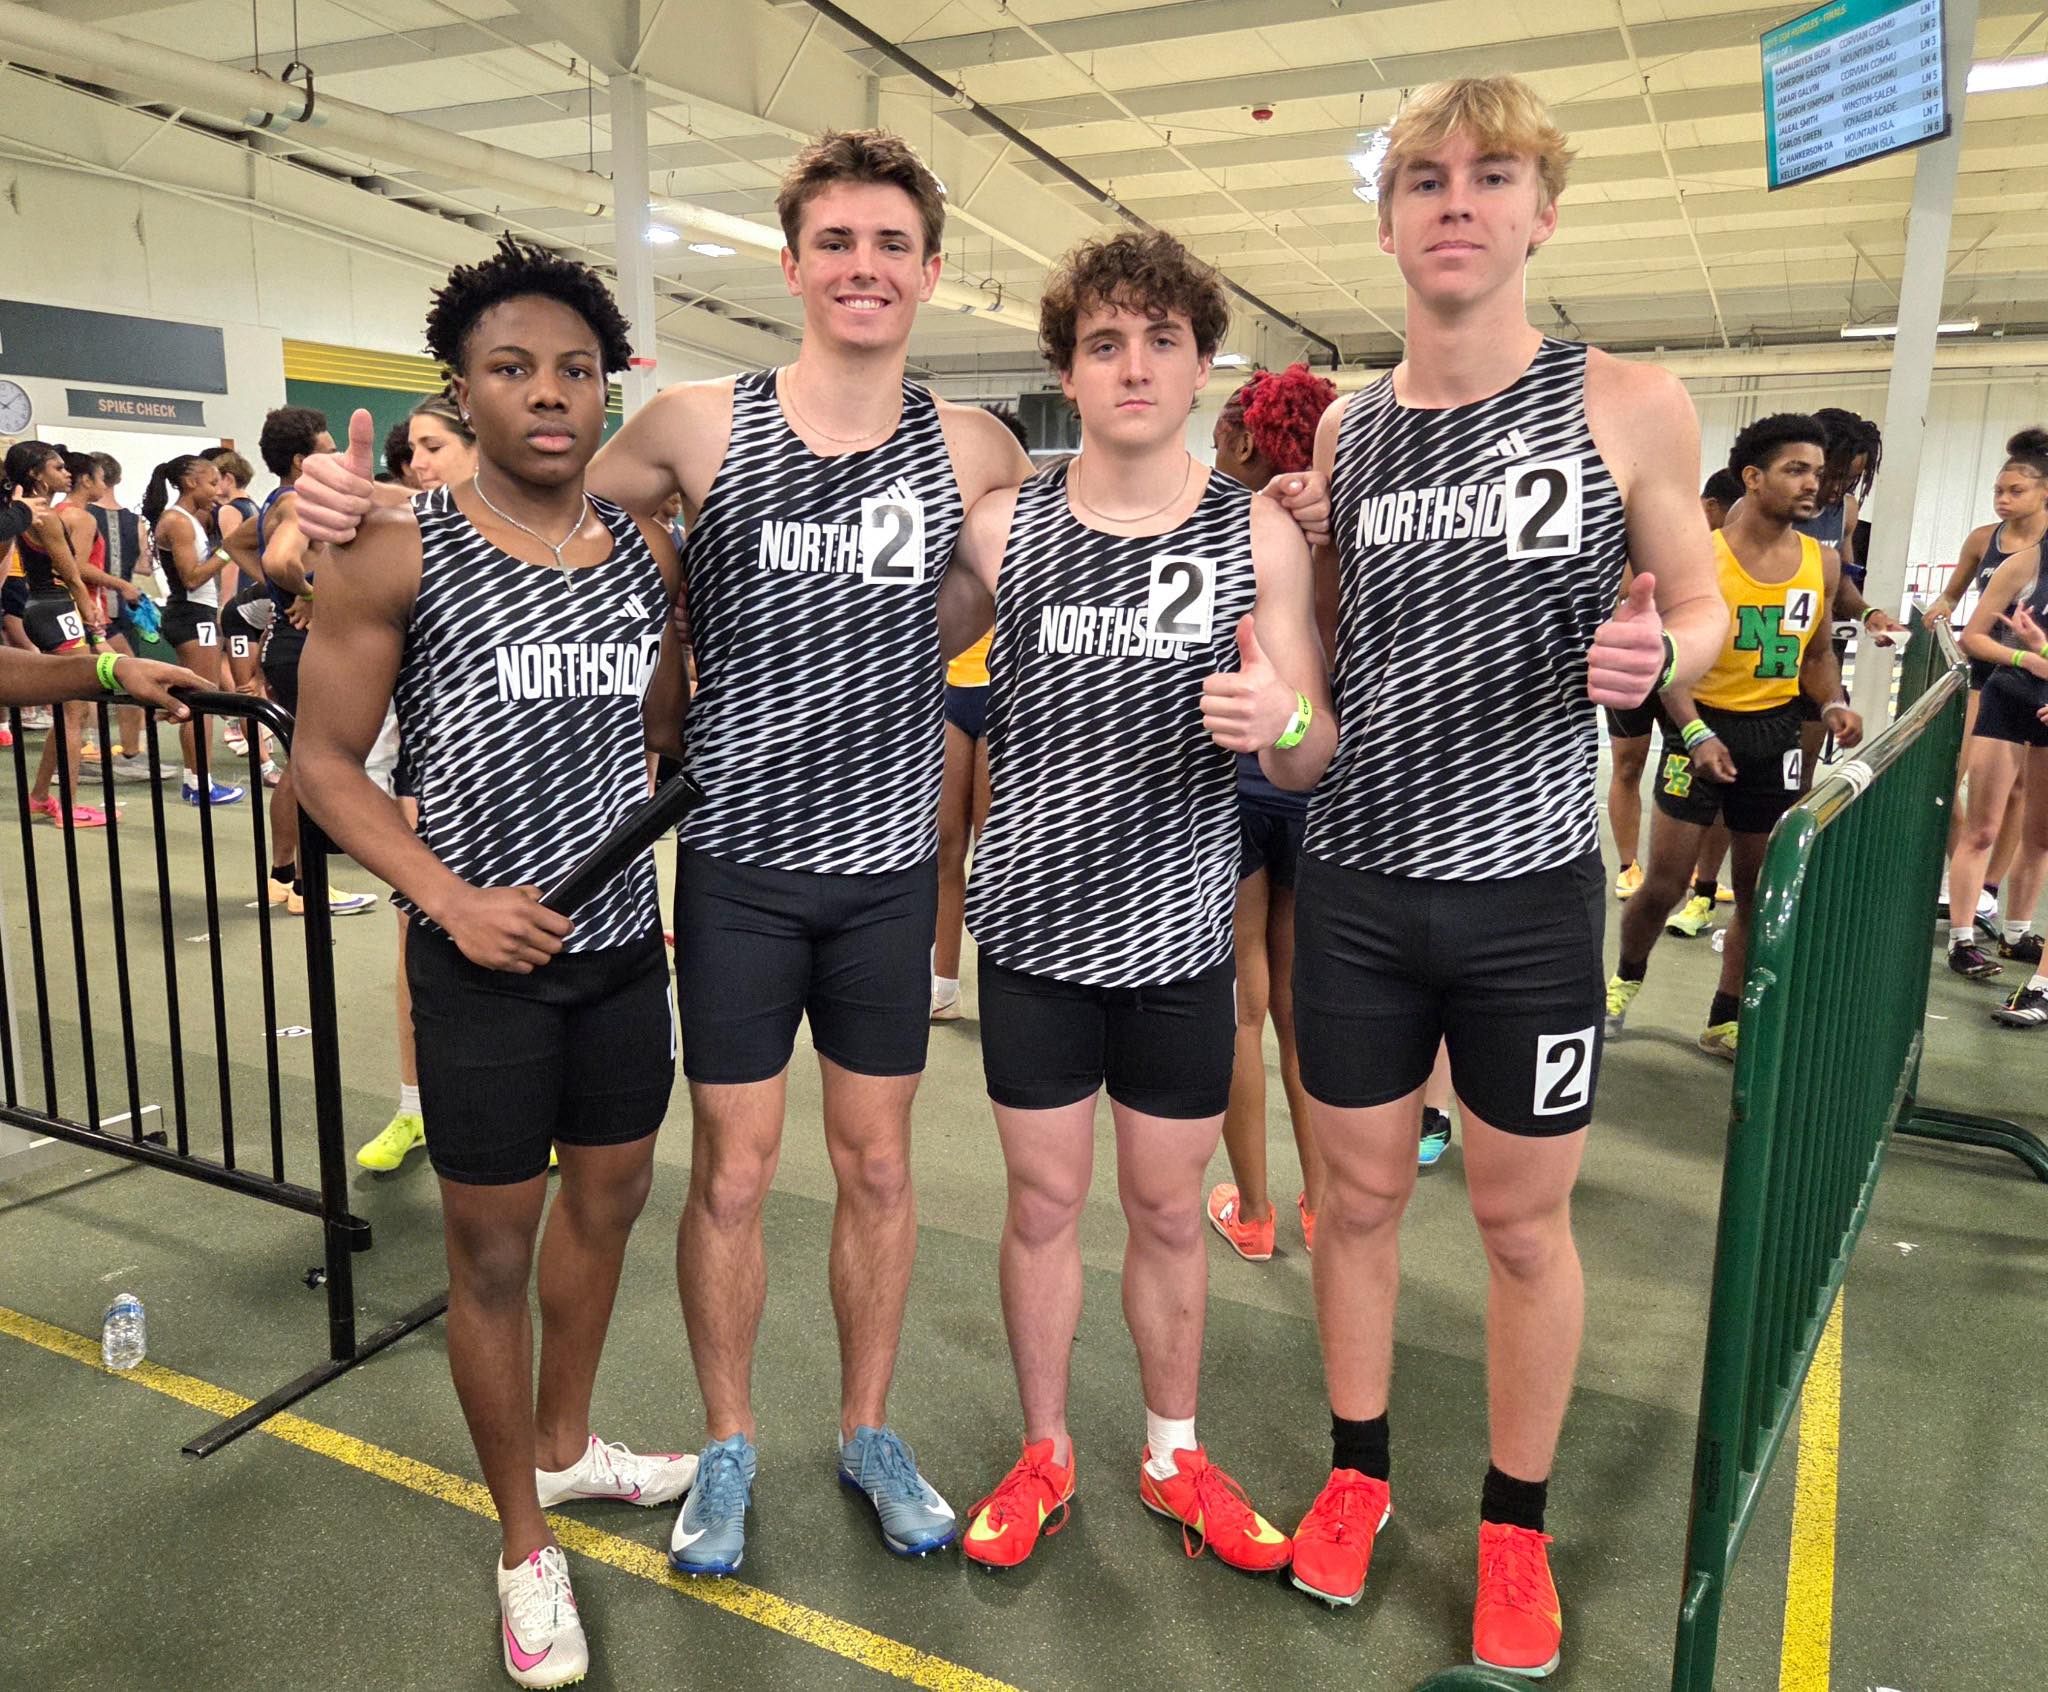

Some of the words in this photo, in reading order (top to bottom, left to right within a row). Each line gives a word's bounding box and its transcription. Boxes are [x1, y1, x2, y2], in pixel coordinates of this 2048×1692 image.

[1920, 5, 1930, 15] LN
[1776, 73, 1805, 92] CAMERON
[1805, 62, 1830, 80] GASTON
[1840, 44, 1874, 65] MOUNTAIN
[1920, 21, 1930, 33] LN
[1920, 39, 1930, 50] LN
[1778, 103, 1806, 122] CAMERON
[1807, 93, 1834, 110] SIMPSON
[1920, 56, 1930, 67] LN
[1799, 114, 1818, 129] SMITH
[1921, 73, 1931, 84] LN
[1779, 135, 1802, 151] CARLOS
[1803, 128, 1822, 143] GREEN
[1843, 110, 1873, 128] VOYAGER
[1922, 90, 1932, 101] LN
[1844, 124, 1878, 145] MOUNTAIN
[1922, 106, 1932, 118] LN
[1802, 157, 1828, 174] MURPHY
[1844, 140, 1879, 161] MOUNTAIN
[1923, 123, 1933, 134] LN
[98, 398, 136, 415] SPIKE
[135, 402, 177, 418] CHECK
[1515, 468, 1570, 553] 2
[758, 519, 863, 574] NORTH
[871, 504, 914, 577] 2
[1154, 561, 1204, 636] 2
[1789, 592, 1811, 629] 4
[64, 615, 80, 636] 8
[200, 625, 211, 644] 7
[233, 637, 246, 656] 5
[1733, 605, 1801, 679] NR
[496, 642, 642, 702] NORTHSID
[1663, 754, 1693, 799] NR
[1787, 752, 1800, 787] 4
[1542, 1038, 1587, 1110] 2
